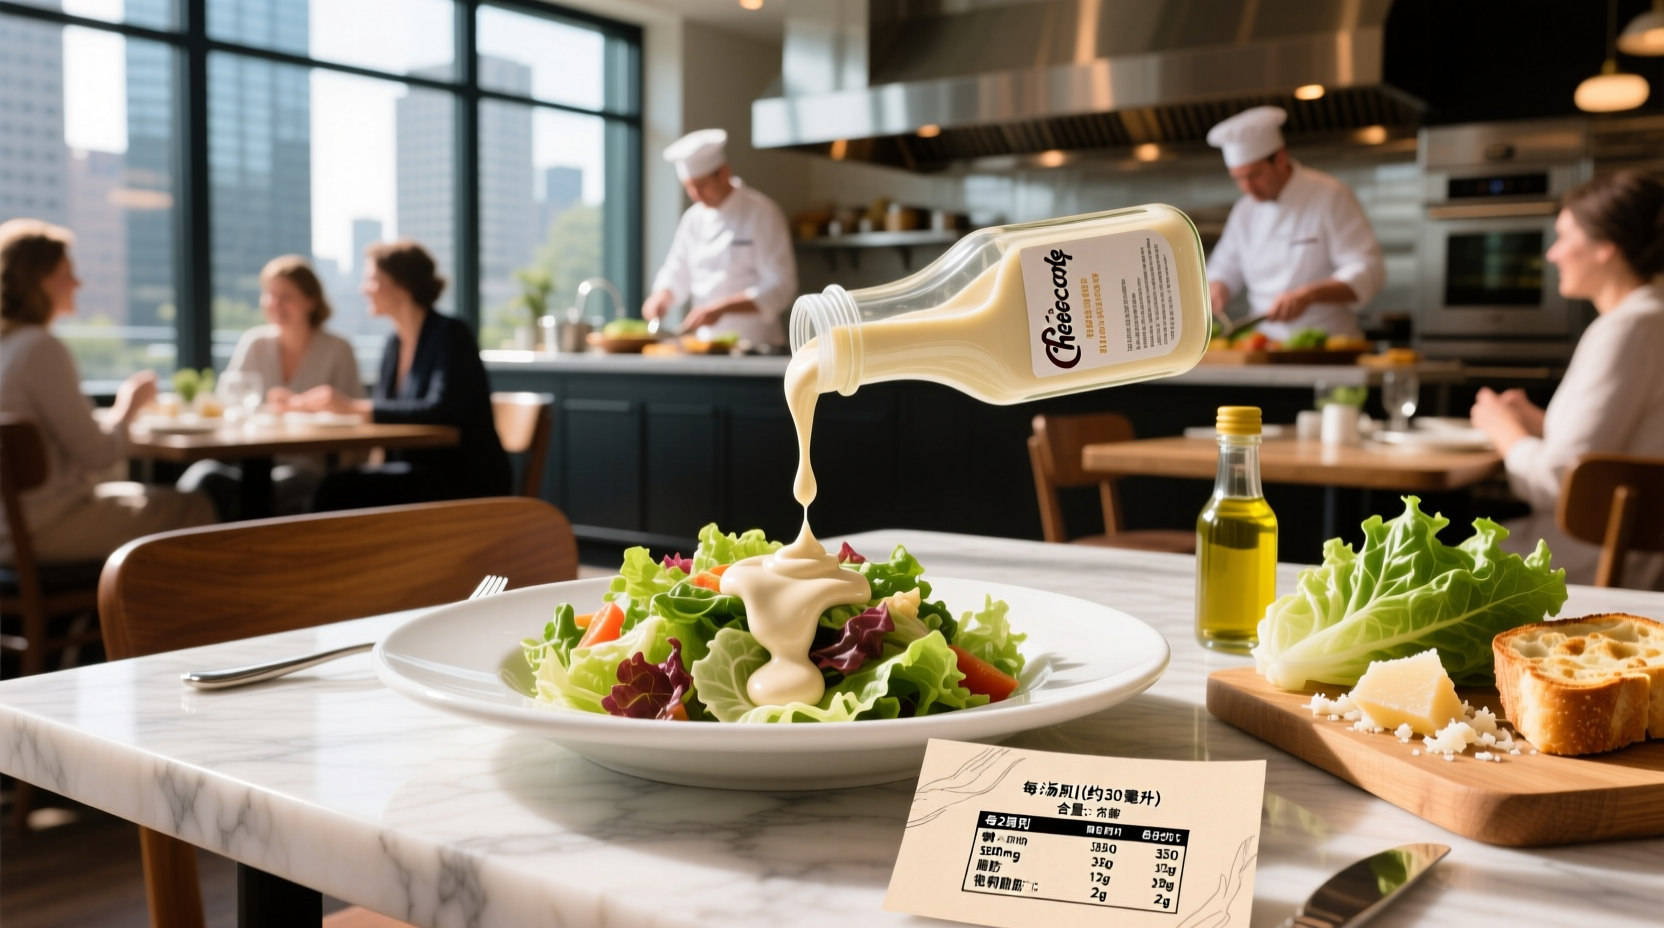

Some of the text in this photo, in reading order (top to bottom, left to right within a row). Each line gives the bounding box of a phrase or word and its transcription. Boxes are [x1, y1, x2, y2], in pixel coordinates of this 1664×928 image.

[1090, 871, 1110, 886] 12g
[1090, 887, 1107, 902] 2g
[1153, 894, 1170, 909] 2g
